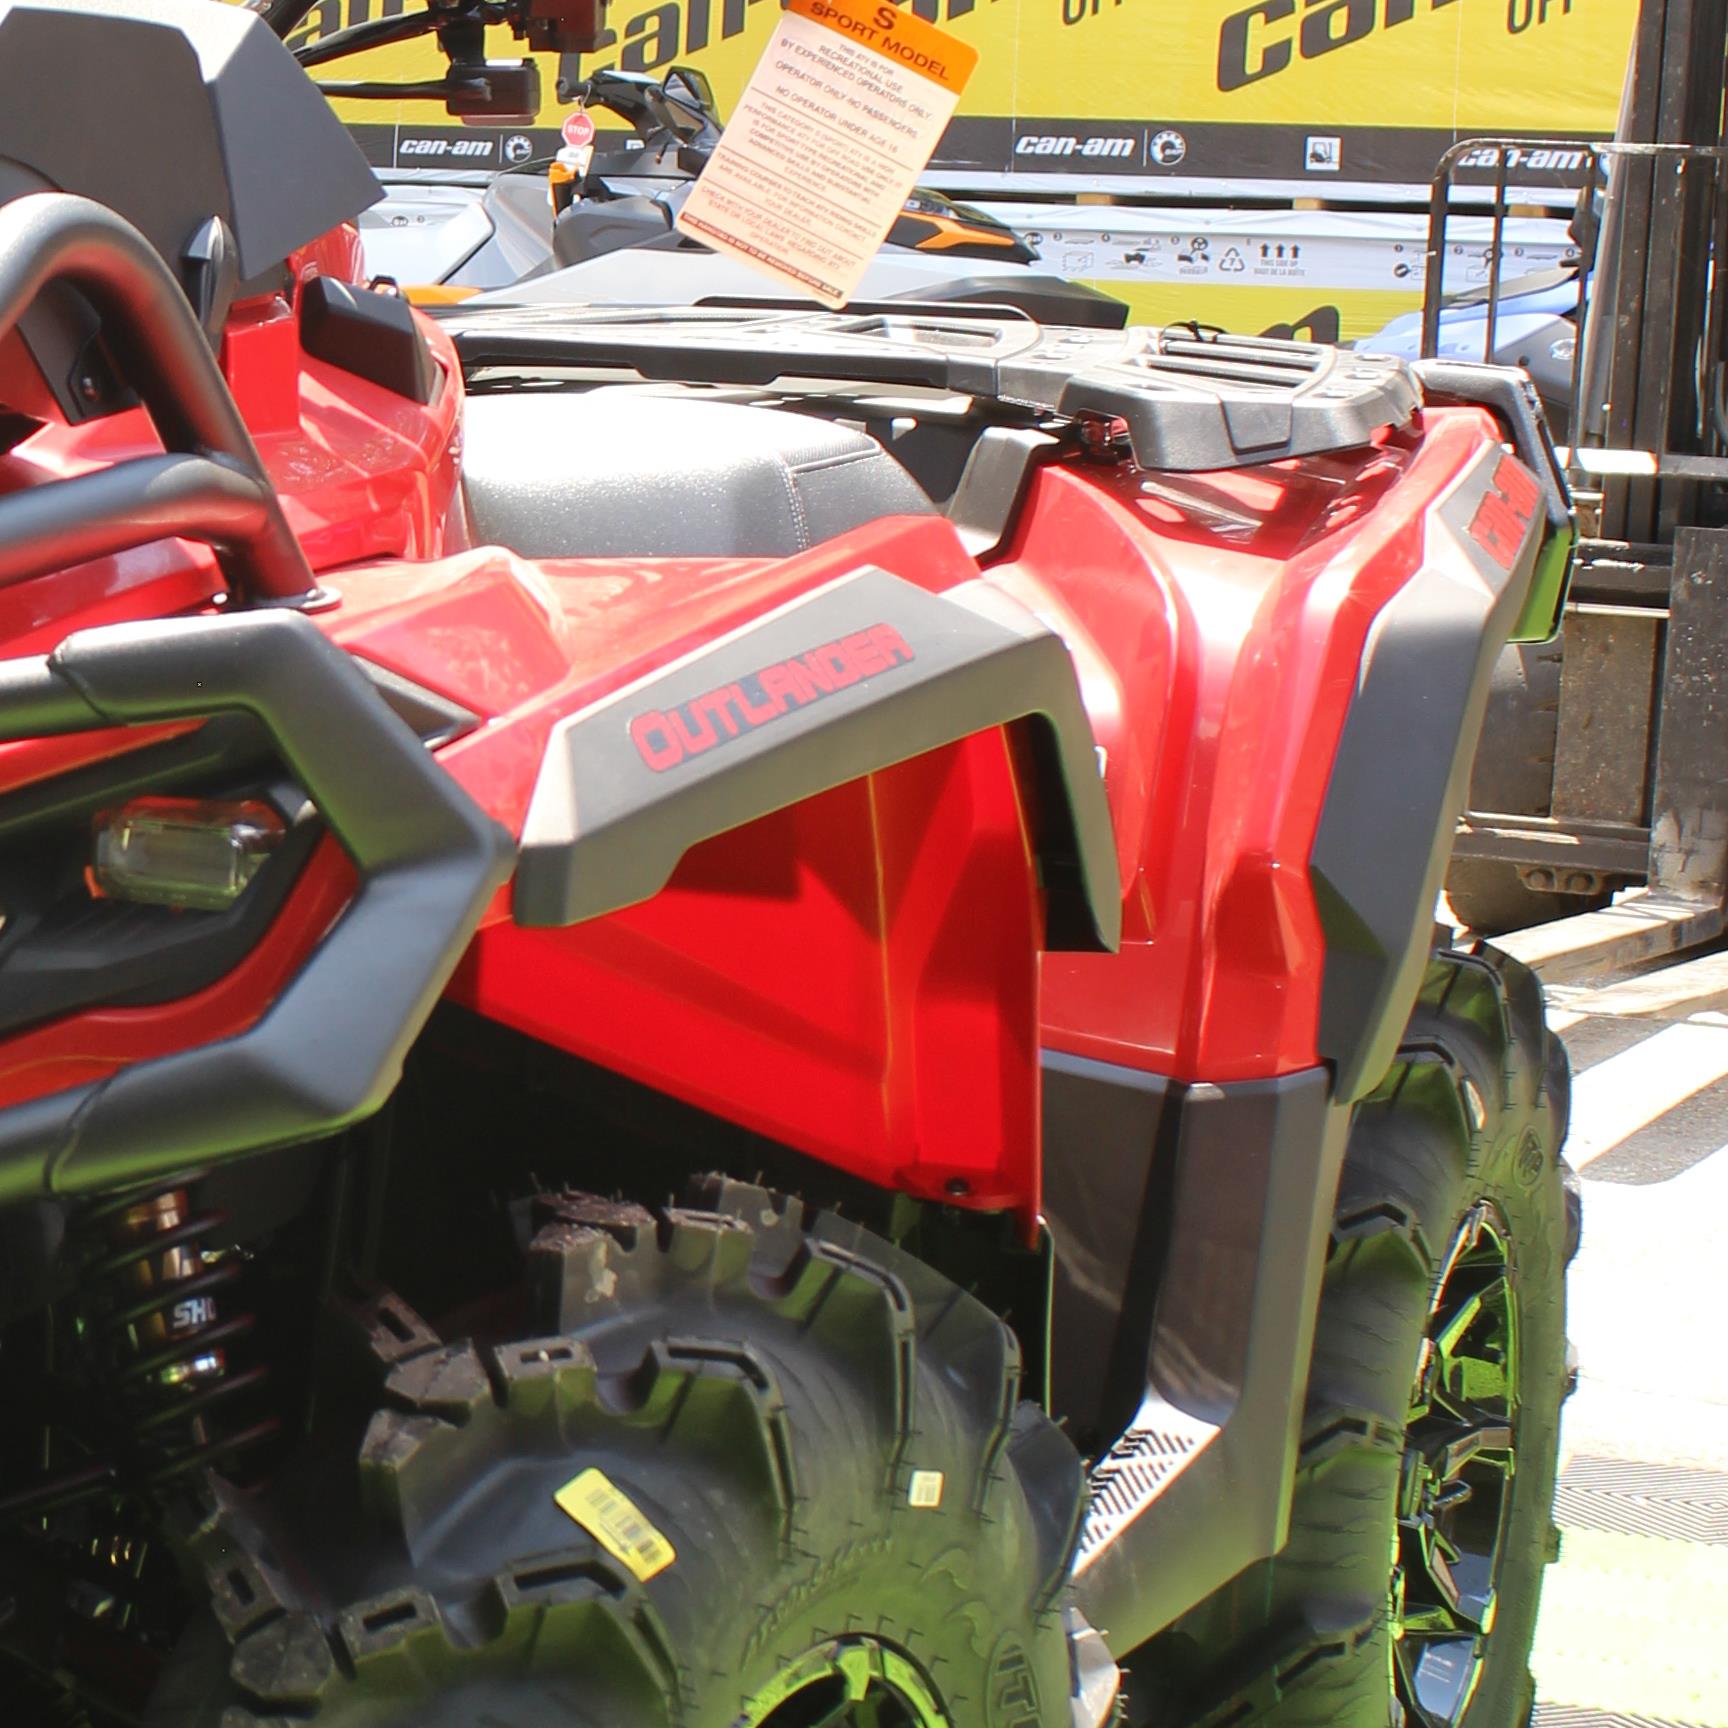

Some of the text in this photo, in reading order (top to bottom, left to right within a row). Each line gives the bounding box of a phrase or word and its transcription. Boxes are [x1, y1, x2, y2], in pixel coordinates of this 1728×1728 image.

[871, 4, 899, 32] S
[809, 0, 953, 80] SPORT MODEL
[774, 60, 823, 89] OPERATOR
[817, 45, 903, 93] RECREATIONAL USE
[568, 124, 590, 136] STOP
[775, 85, 790, 98] NO
[789, 93, 837, 121] OPERATOR
[837, 117, 868, 138] UNDER
[867, 132, 887, 147] AGE
[399, 137, 494, 158] can-am
[1015, 134, 1136, 158] can-am
[629, 622, 915, 772] OUTLANDER
